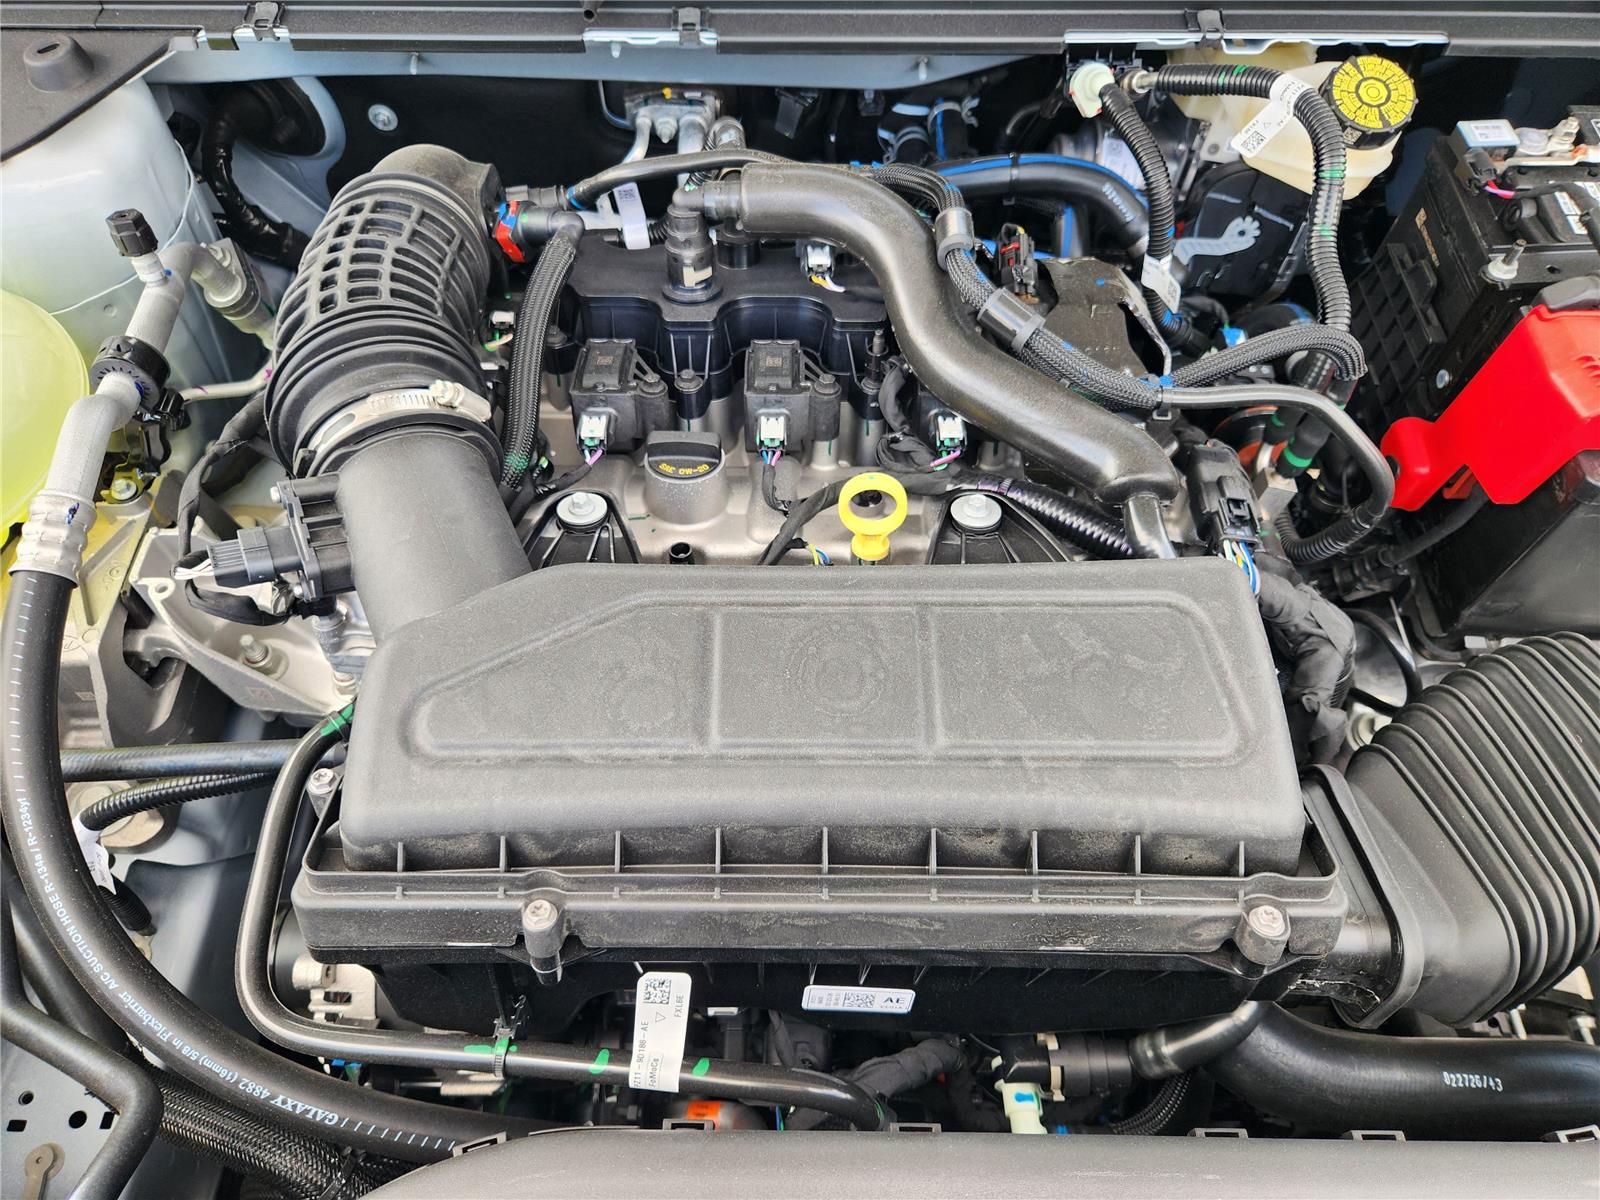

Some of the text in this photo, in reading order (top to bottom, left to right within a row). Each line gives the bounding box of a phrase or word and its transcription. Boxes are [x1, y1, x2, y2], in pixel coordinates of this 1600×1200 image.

[34, 853, 55, 893] R-134a
[48, 893, 72, 926] HOSE
[66, 925, 104, 973] SUCTION
[100, 972, 120, 990] A/C
[884, 996, 906, 1005] AE
[118, 991, 174, 1043] Flexbarrier
[181, 1045, 200, 1061] 5/8
[199, 1055, 239, 1083] (16mm)
[238, 1078, 271, 1099] 4882
[270, 1094, 339, 1125] GALAXY
